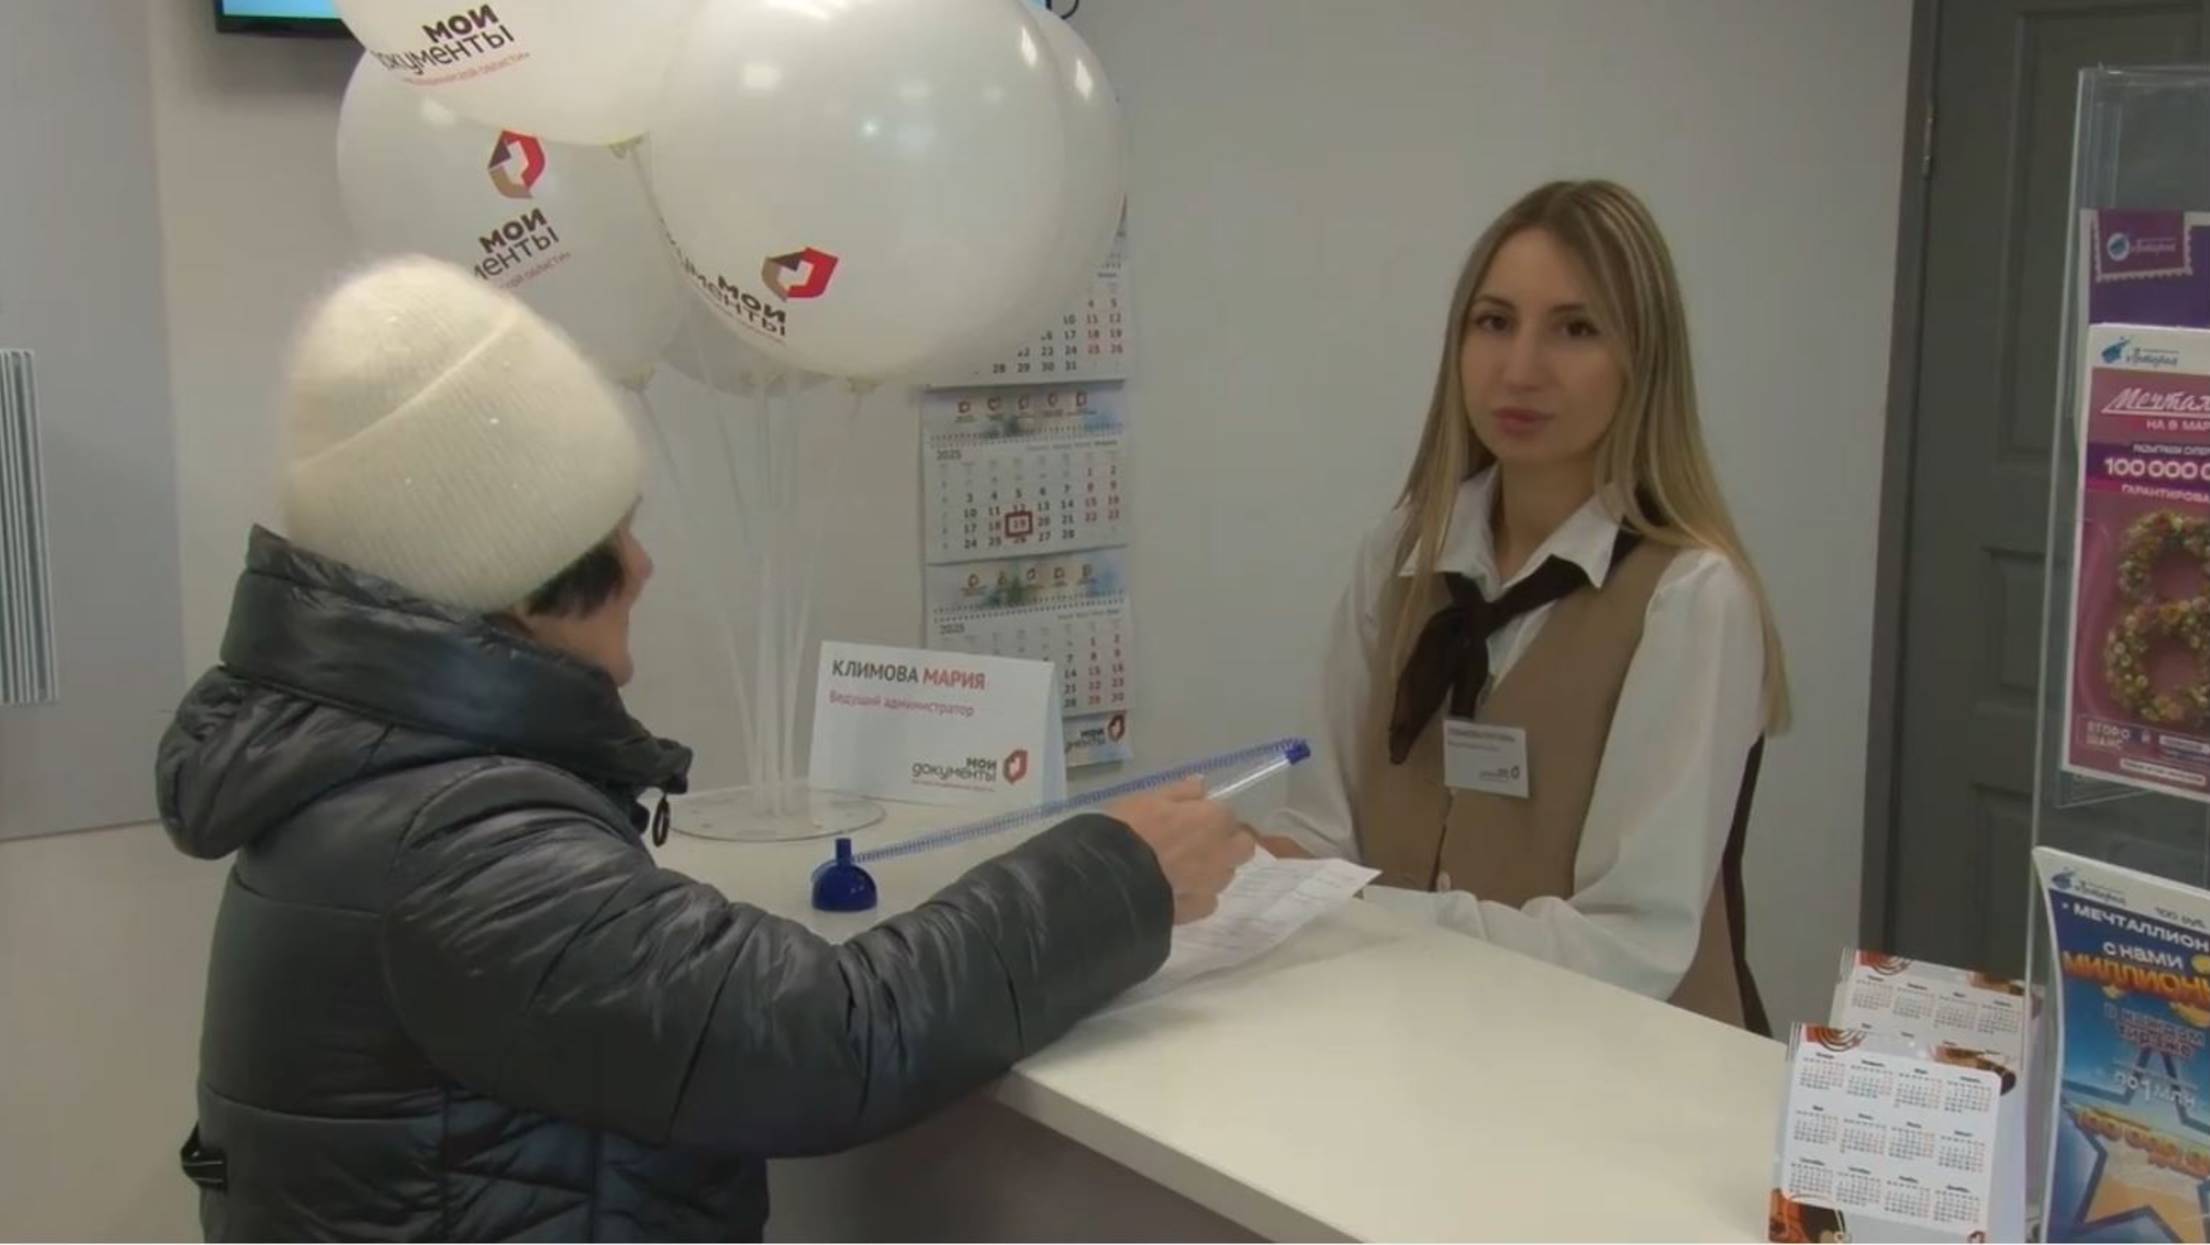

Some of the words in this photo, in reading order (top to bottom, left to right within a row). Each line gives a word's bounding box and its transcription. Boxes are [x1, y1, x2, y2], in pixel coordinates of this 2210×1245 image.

[2105, 458, 2145, 477] 100
[2148, 460, 2198, 480] 000
[832, 659, 918, 685] КЛИМОВА
[923, 667, 986, 690] МАРИЯ
[2073, 902, 2209, 952] МЕЧТАЛЛИОН
